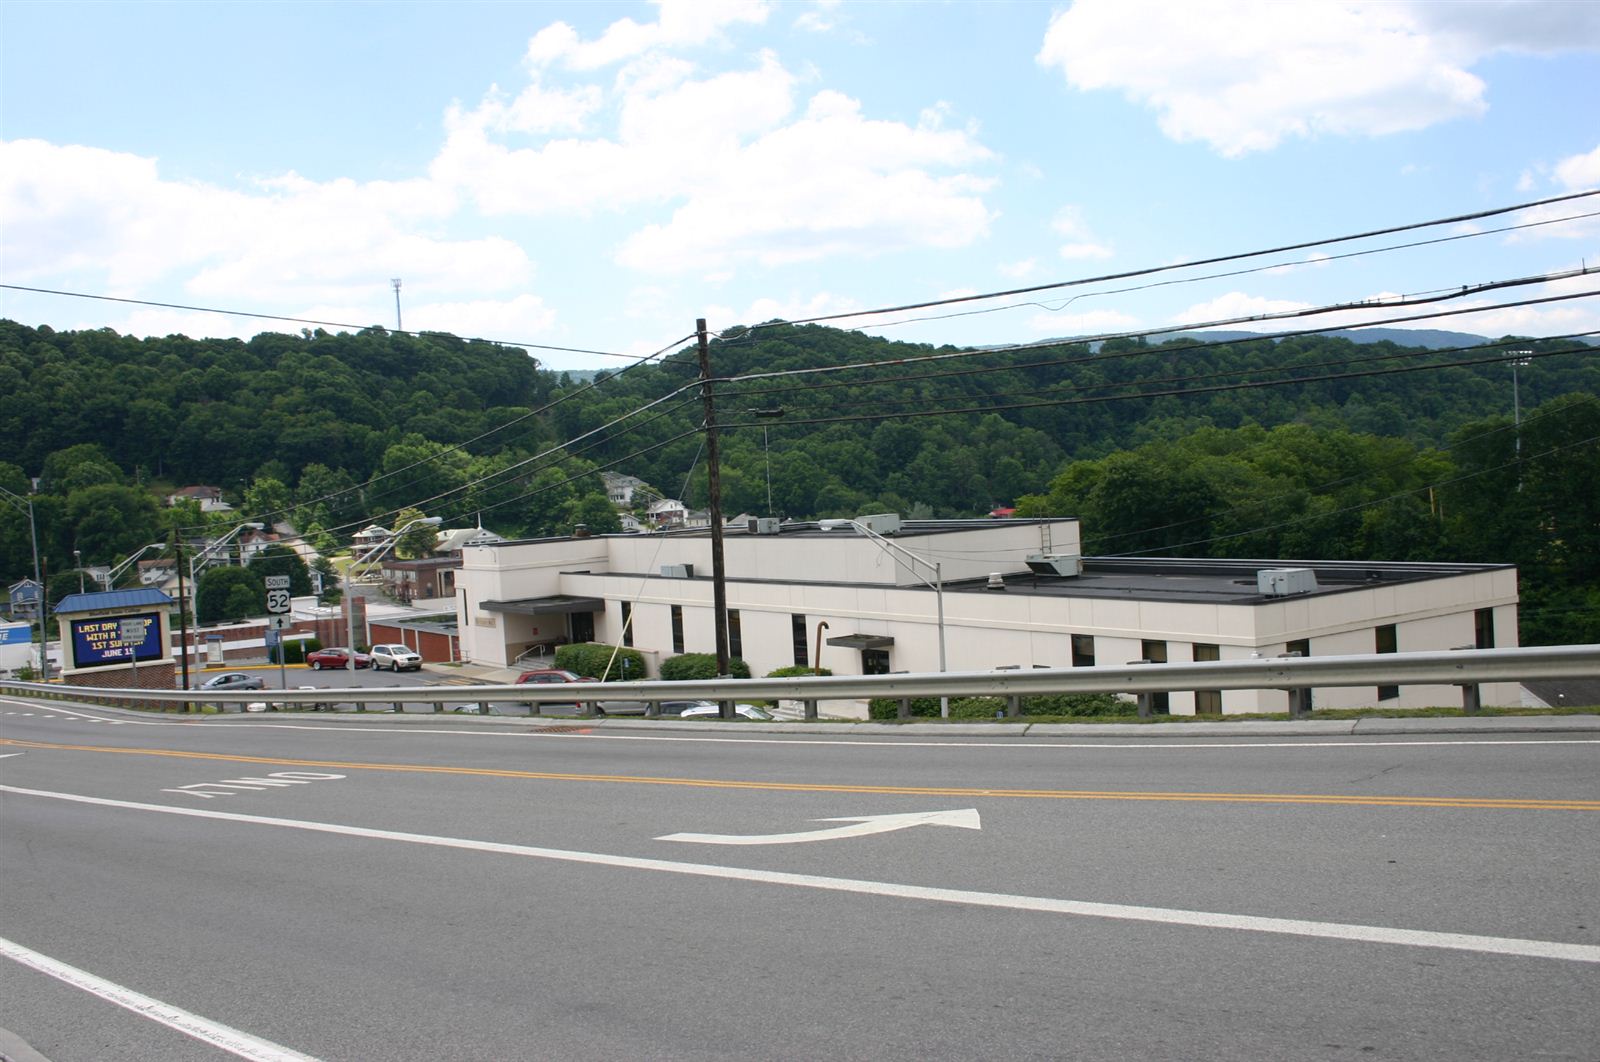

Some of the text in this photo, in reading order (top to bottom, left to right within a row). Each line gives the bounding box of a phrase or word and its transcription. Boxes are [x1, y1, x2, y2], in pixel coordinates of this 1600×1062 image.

[267, 578, 288, 586] SOUTH
[270, 594, 288, 608] 52
[79, 625, 99, 633] LAST
[86, 633, 108, 641] WITH
[102, 649, 122, 657] JUNE
